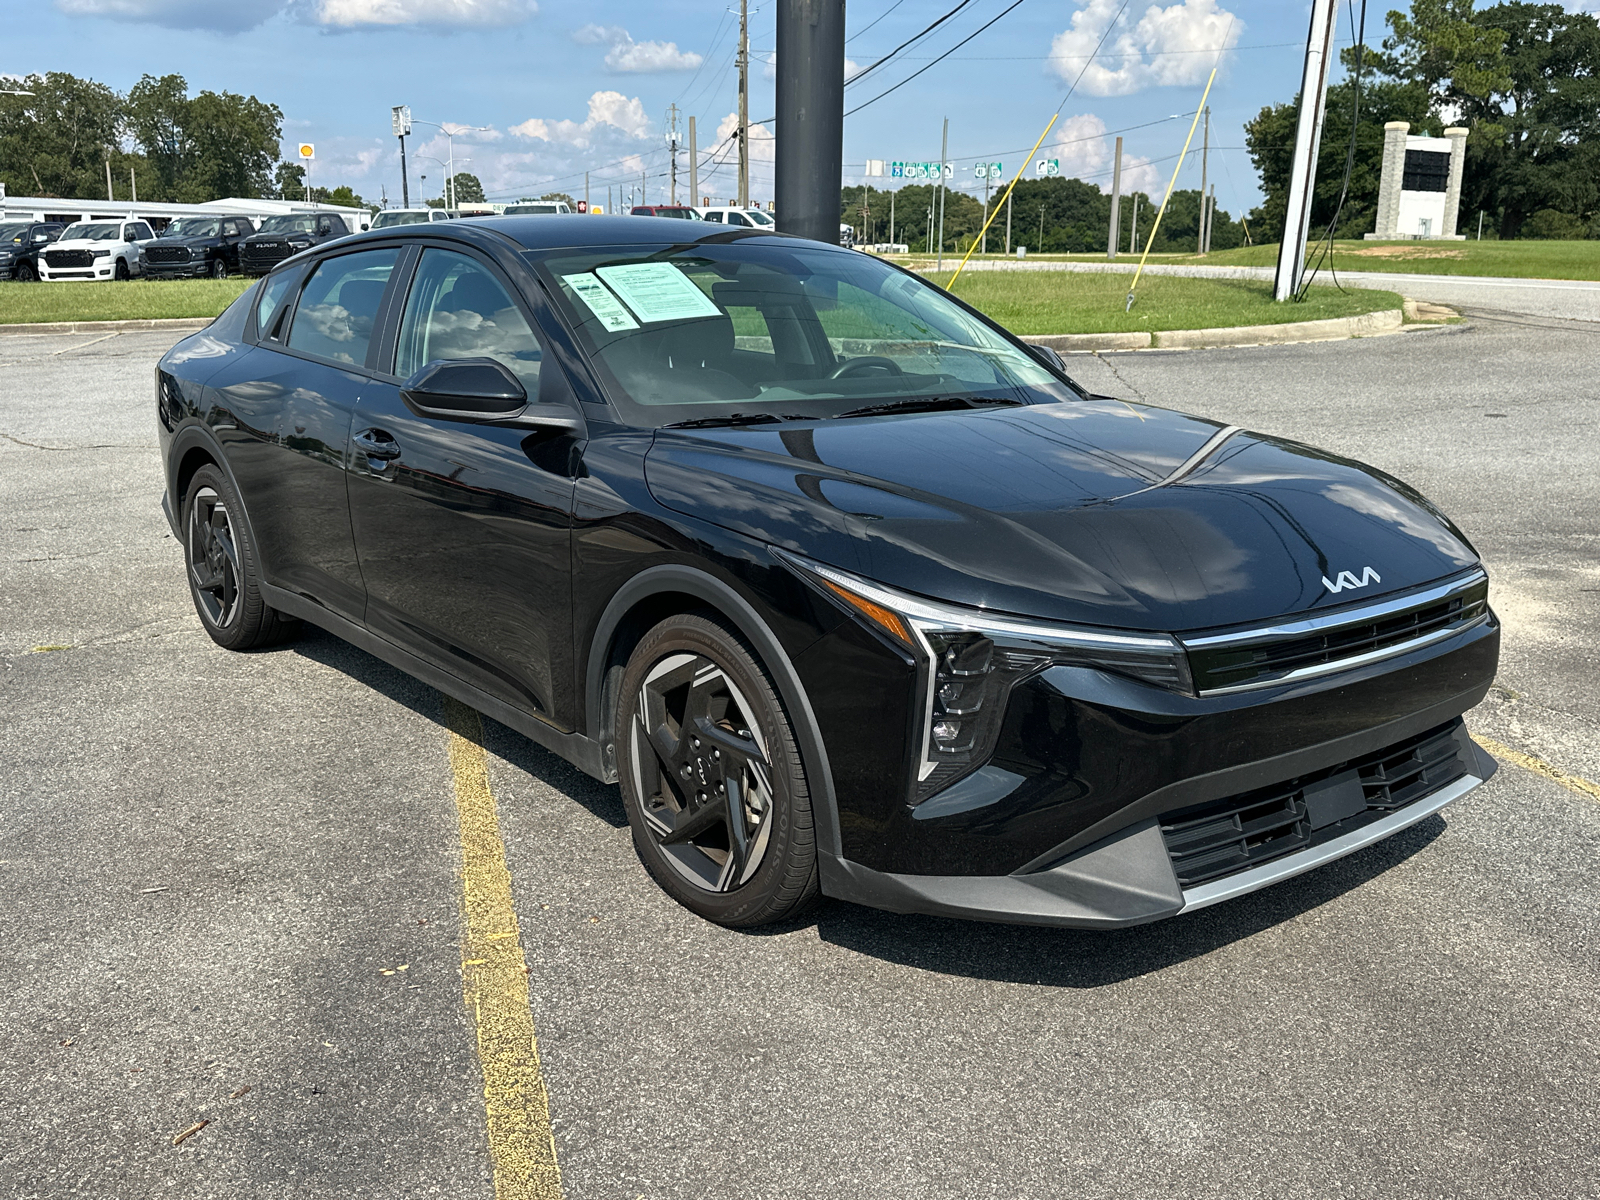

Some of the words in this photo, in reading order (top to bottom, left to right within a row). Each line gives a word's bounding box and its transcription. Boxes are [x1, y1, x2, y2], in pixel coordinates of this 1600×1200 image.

[1321, 566, 1381, 594] KIA
[711, 642, 748, 680] ALL-SEASON
[615, 677, 629, 741] KUMHO
[772, 800, 788, 870] SOLUS
